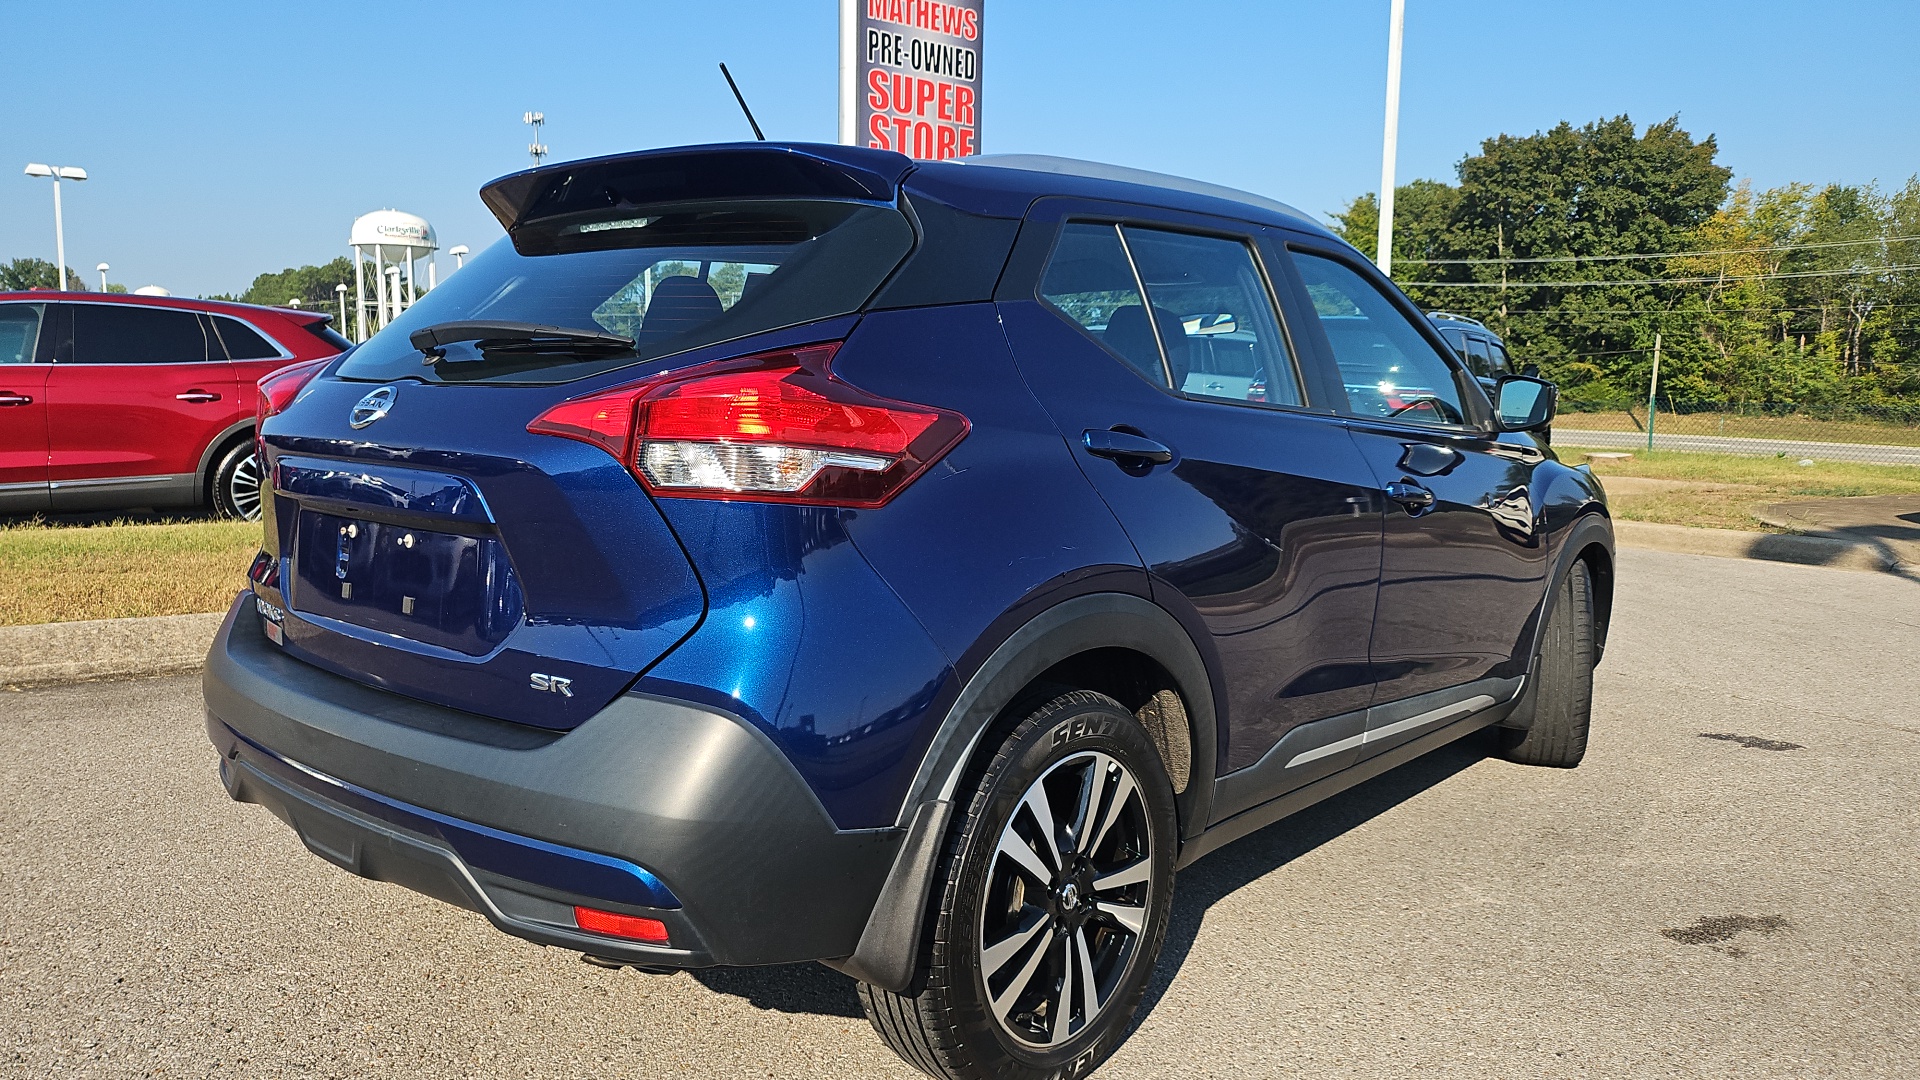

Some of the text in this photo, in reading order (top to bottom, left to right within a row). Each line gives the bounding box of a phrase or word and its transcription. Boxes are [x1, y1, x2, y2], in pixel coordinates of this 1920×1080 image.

[868, 0, 977, 40] MATHEWS
[868, 29, 975, 80] PRE-OWNED
[869, 70, 975, 125] SUPER
[870, 114, 975, 160] STORE
[530, 673, 574, 697] SR
